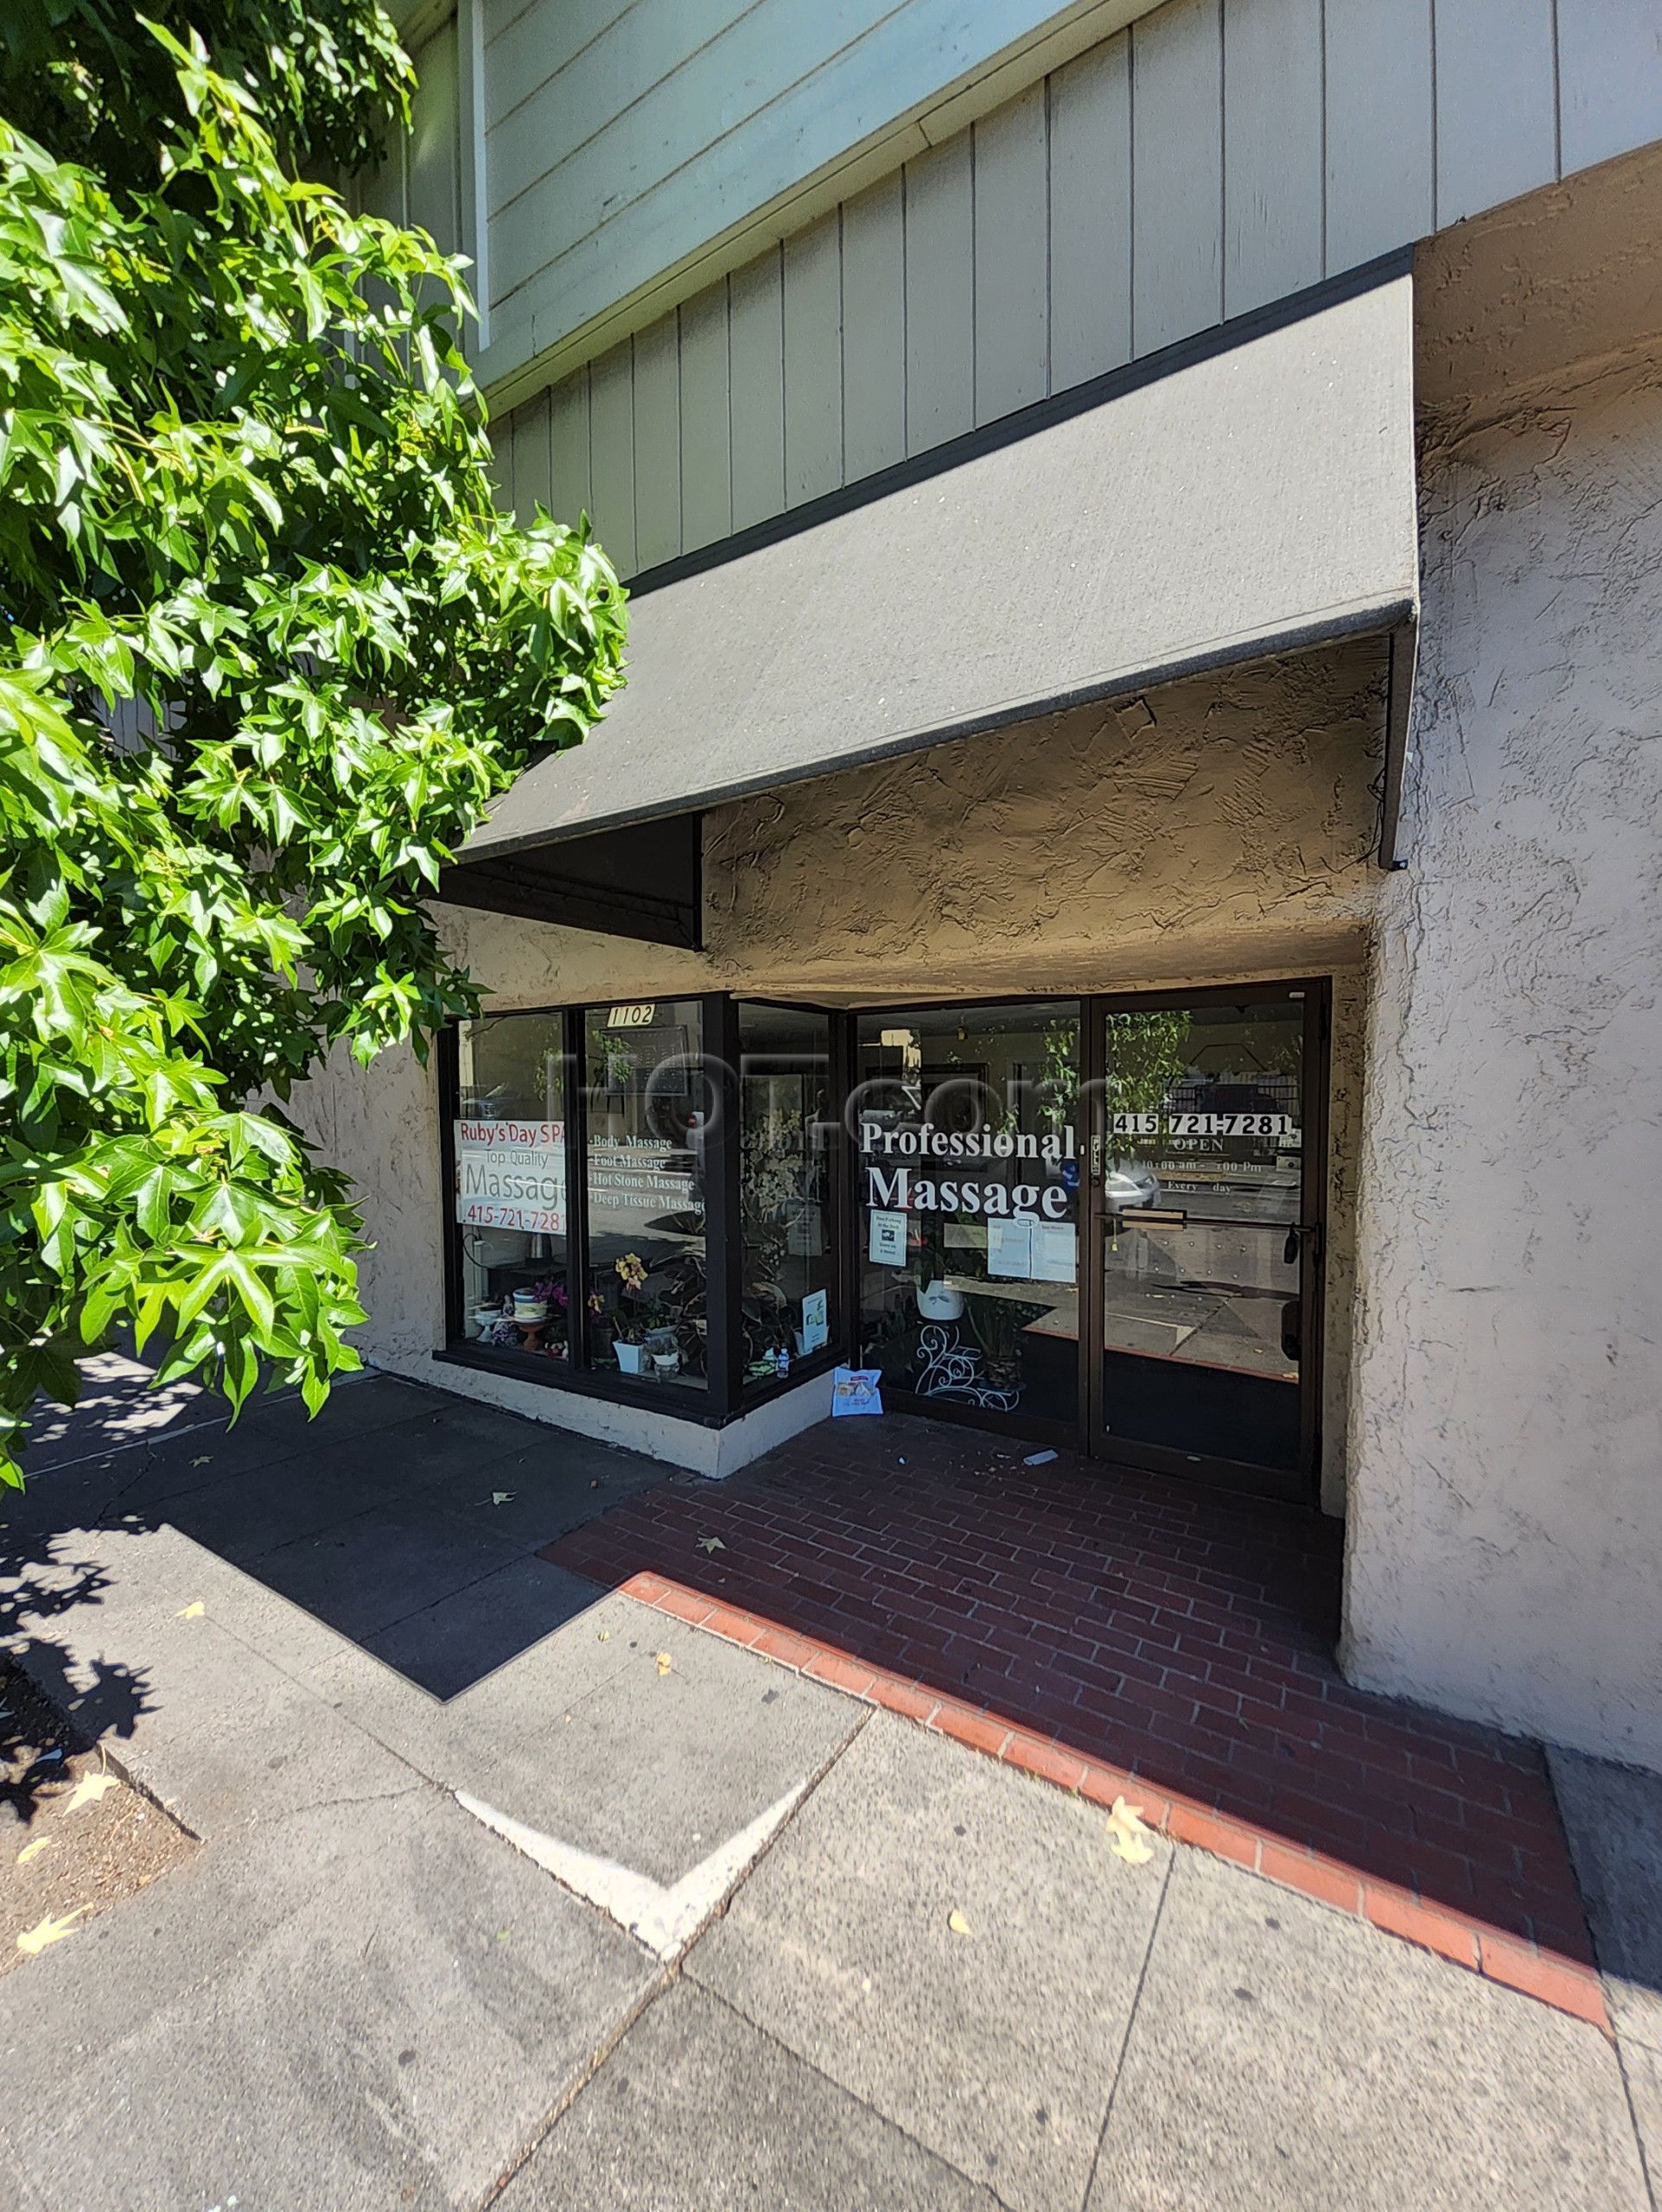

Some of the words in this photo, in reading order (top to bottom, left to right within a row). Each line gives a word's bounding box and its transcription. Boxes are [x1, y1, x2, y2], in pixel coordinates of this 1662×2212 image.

[612, 1006, 652, 1025] 1102
[461, 1122, 506, 1146] Ruby's
[508, 1124, 537, 1147] Day
[1115, 1115, 1157, 1133] 415
[1170, 1115, 1288, 1135] 721-7281
[593, 1135, 620, 1150] Body
[626, 1135, 672, 1152] Massage
[860, 1122, 1076, 1160] Professional
[1174, 1138, 1224, 1152] OPEN
[485, 1149, 506, 1166] Top
[510, 1150, 549, 1169] Quality
[594, 1154, 617, 1166] Foot
[621, 1154, 666, 1171] Massage
[593, 1172, 612, 1185] Hot
[614, 1173, 644, 1187] Stone
[646, 1175, 695, 1193] Massage
[1168, 1180, 1199, 1192] Every
[1212, 1183, 1232, 1195] day
[594, 1192, 620, 1208] Deep
[622, 1193, 656, 1208] Tissue
[865, 1166, 1068, 1229] Massage
